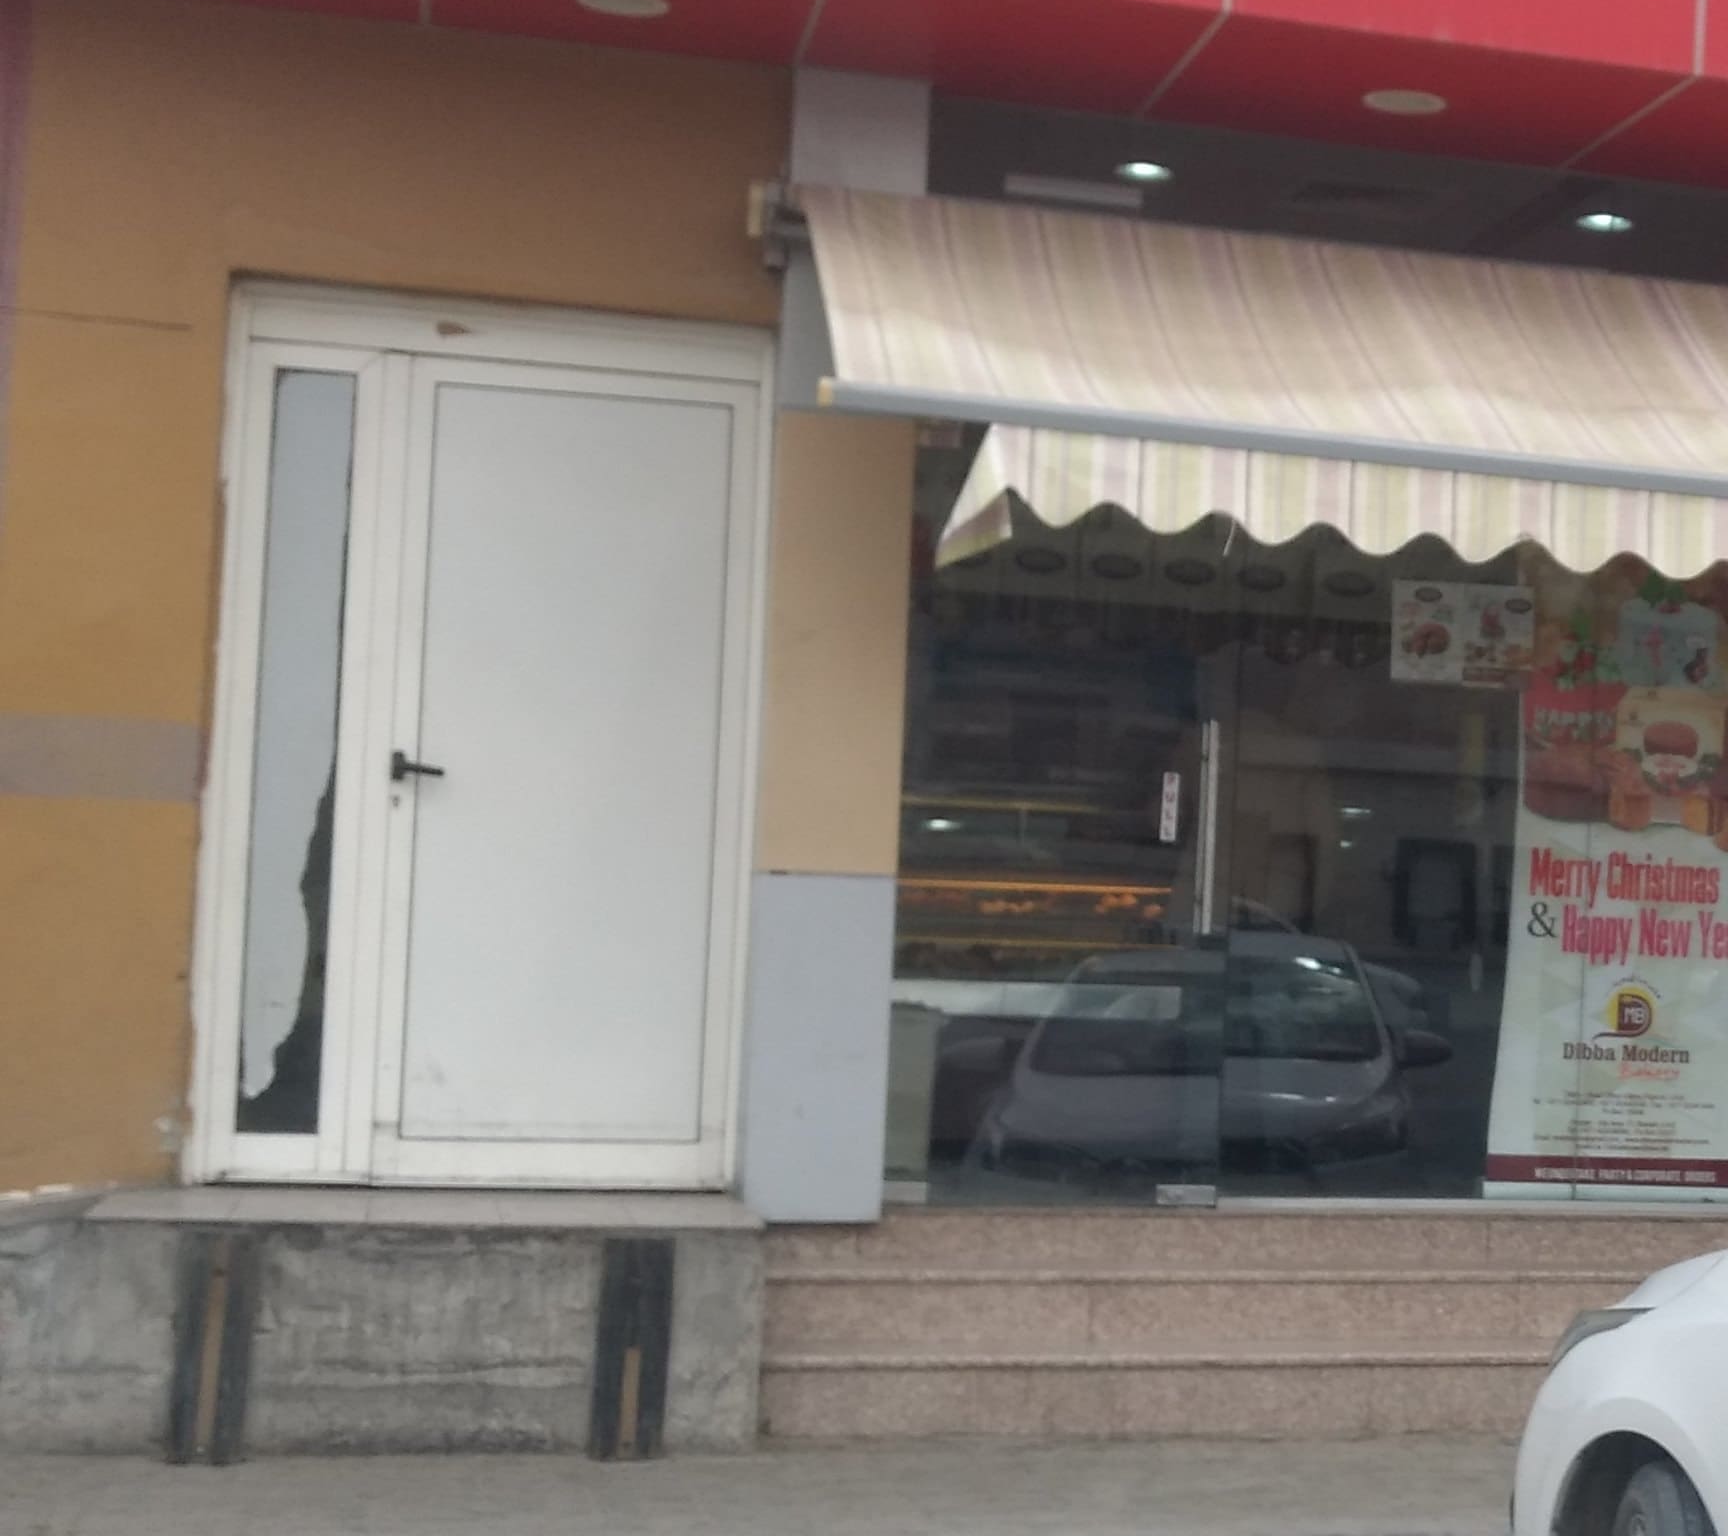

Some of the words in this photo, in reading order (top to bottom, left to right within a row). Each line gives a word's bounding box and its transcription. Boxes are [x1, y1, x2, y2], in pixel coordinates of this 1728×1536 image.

[1530, 847, 1600, 907] Merry
[1606, 851, 1720, 904] Christmas
[1526, 901, 1557, 938] &
[1562, 904, 1633, 965] Happy
[1639, 908, 1692, 958] New
[1562, 1042, 1617, 1061] Dibba
[1621, 1045, 1690, 1064] Modern
